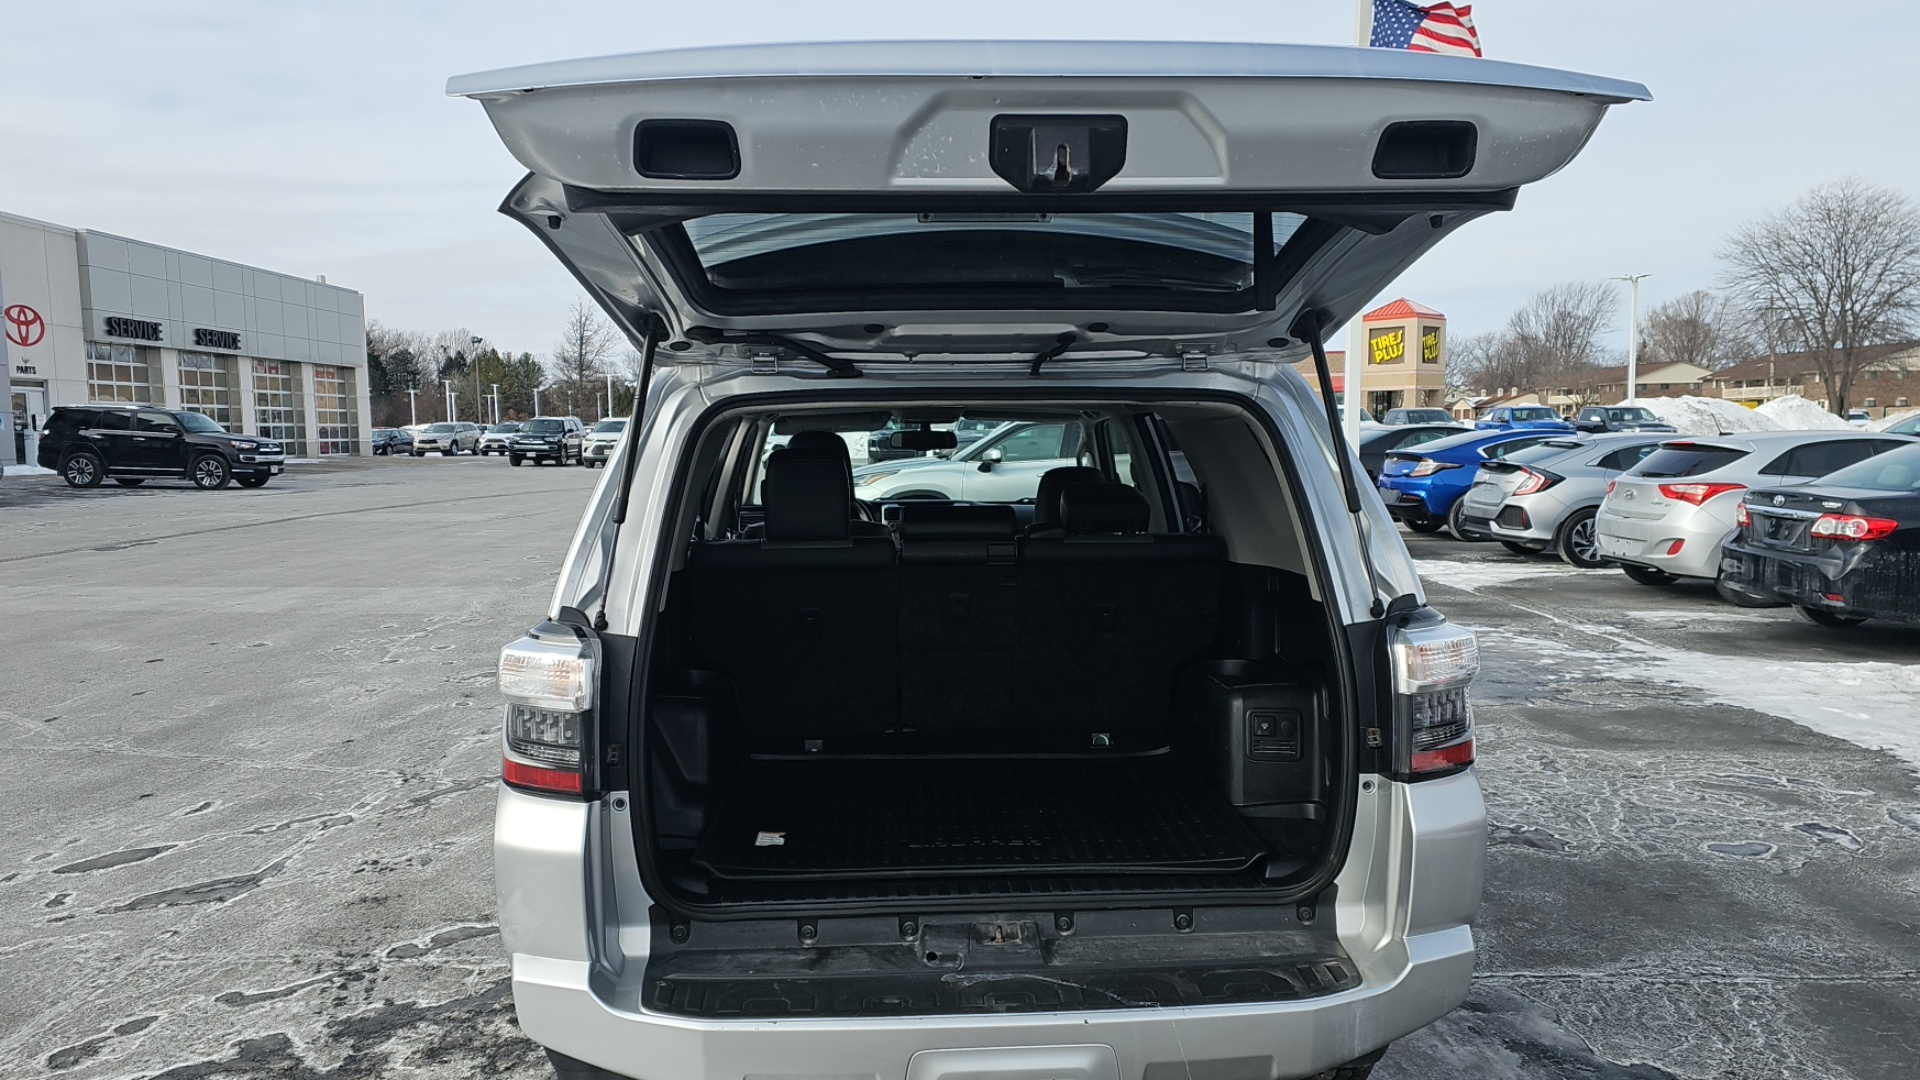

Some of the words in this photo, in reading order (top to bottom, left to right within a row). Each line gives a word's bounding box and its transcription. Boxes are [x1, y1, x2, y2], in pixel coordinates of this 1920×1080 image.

[106, 316, 163, 341] SERVICE
[196, 328, 242, 350] SERVICE
[1422, 331, 1439, 348] TIRES
[1370, 329, 1403, 351] TIRES
[1374, 341, 1404, 364] PLUS
[1423, 343, 1439, 361] PLUS
[16, 365, 37, 375] PARTS
